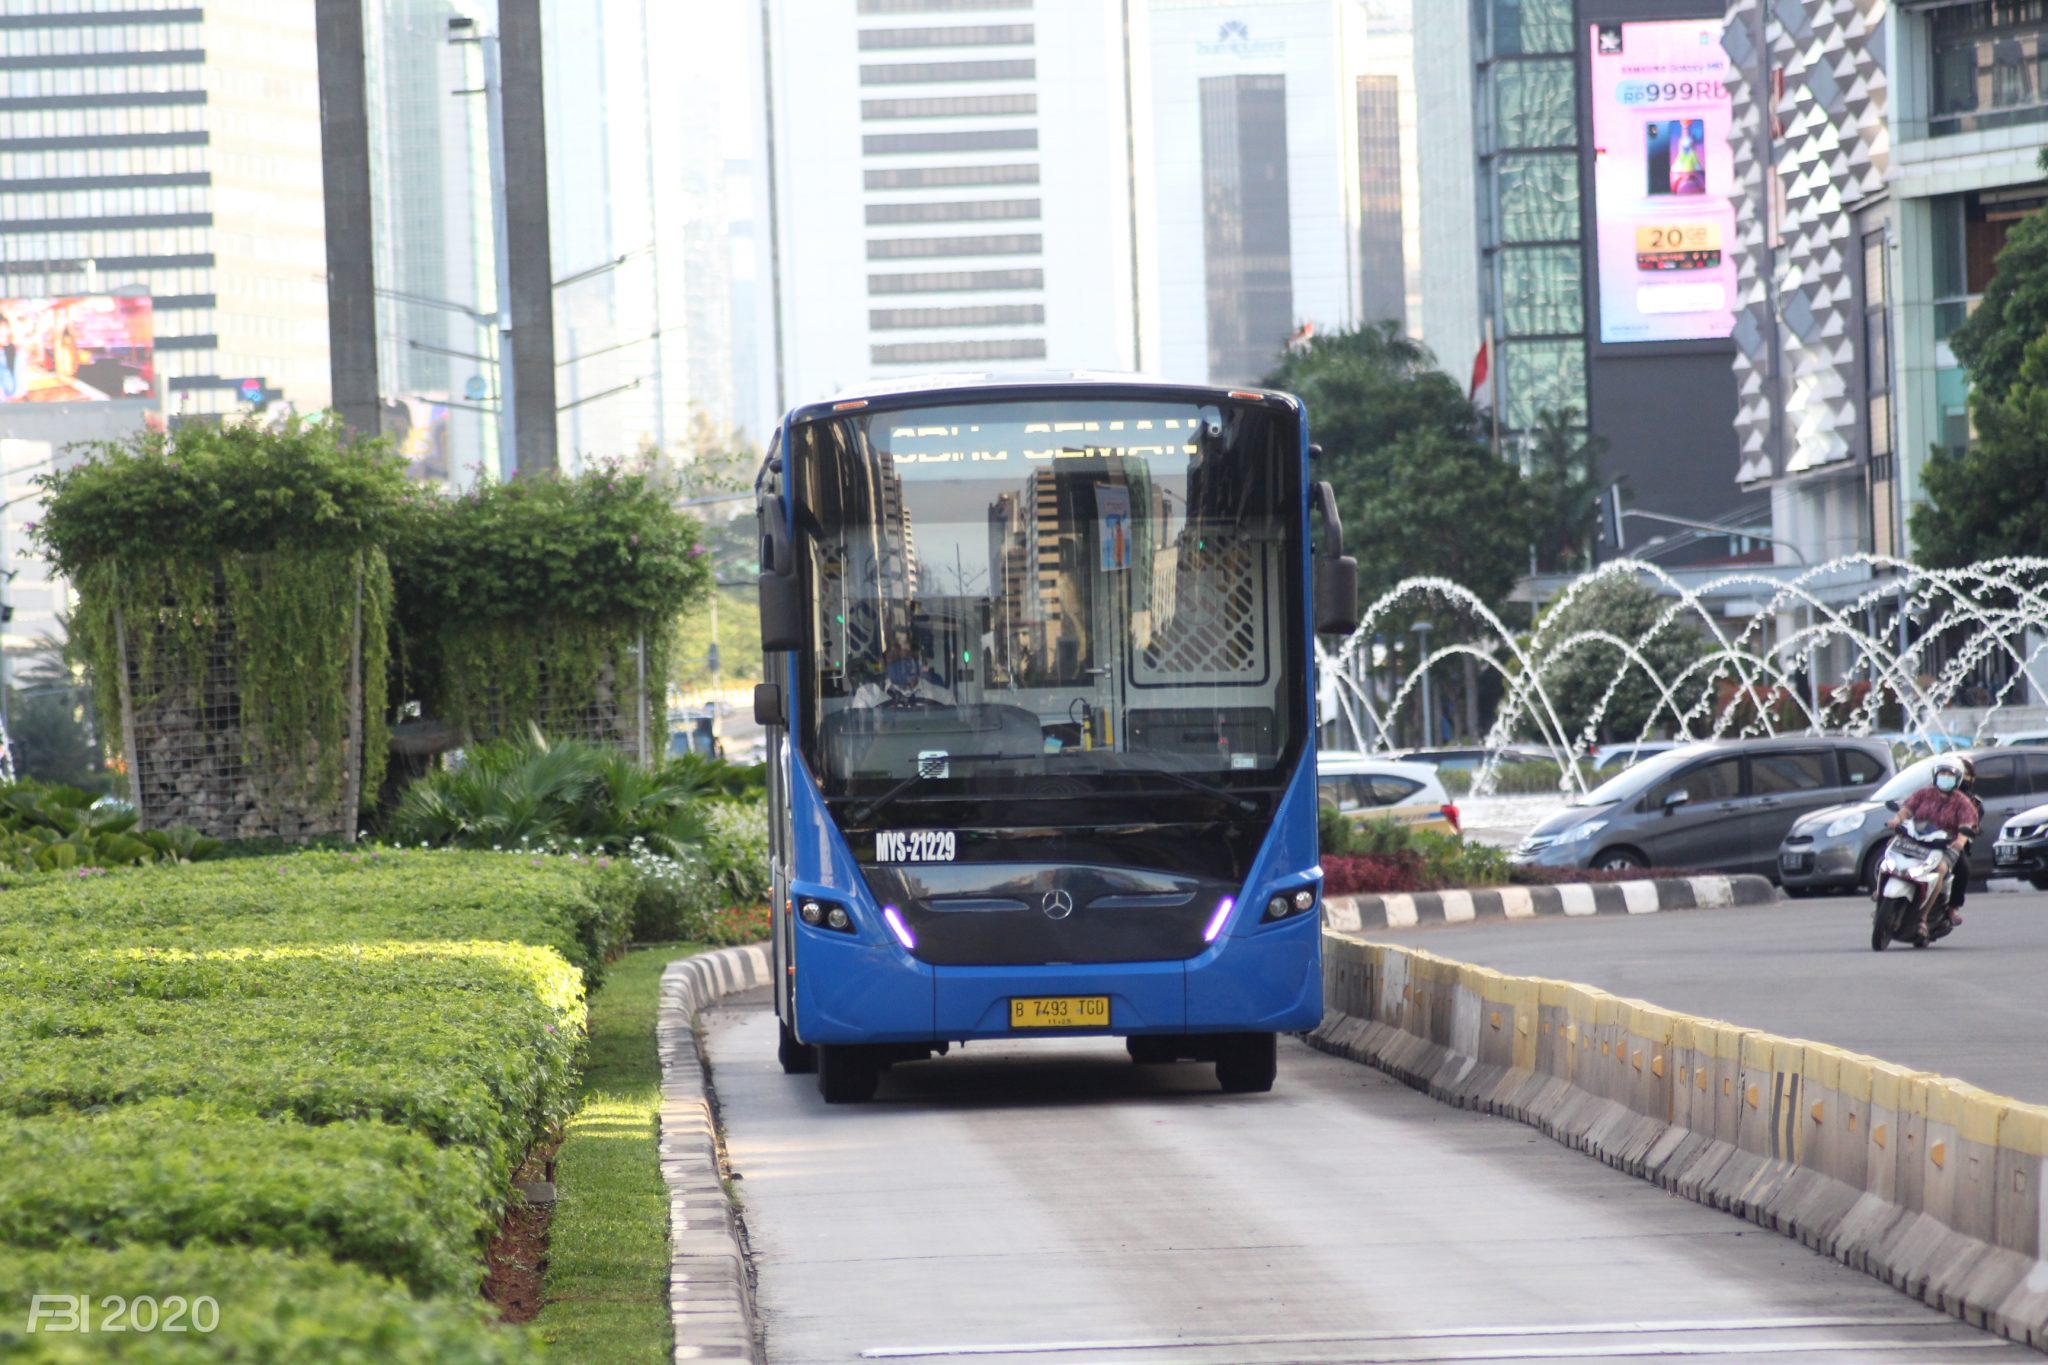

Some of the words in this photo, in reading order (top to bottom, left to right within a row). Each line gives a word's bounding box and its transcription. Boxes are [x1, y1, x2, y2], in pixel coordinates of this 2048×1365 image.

[876, 831, 956, 862] MYS-21229
[1016, 1002, 1024, 1017] B
[1033, 1001, 1068, 1016] 7493
